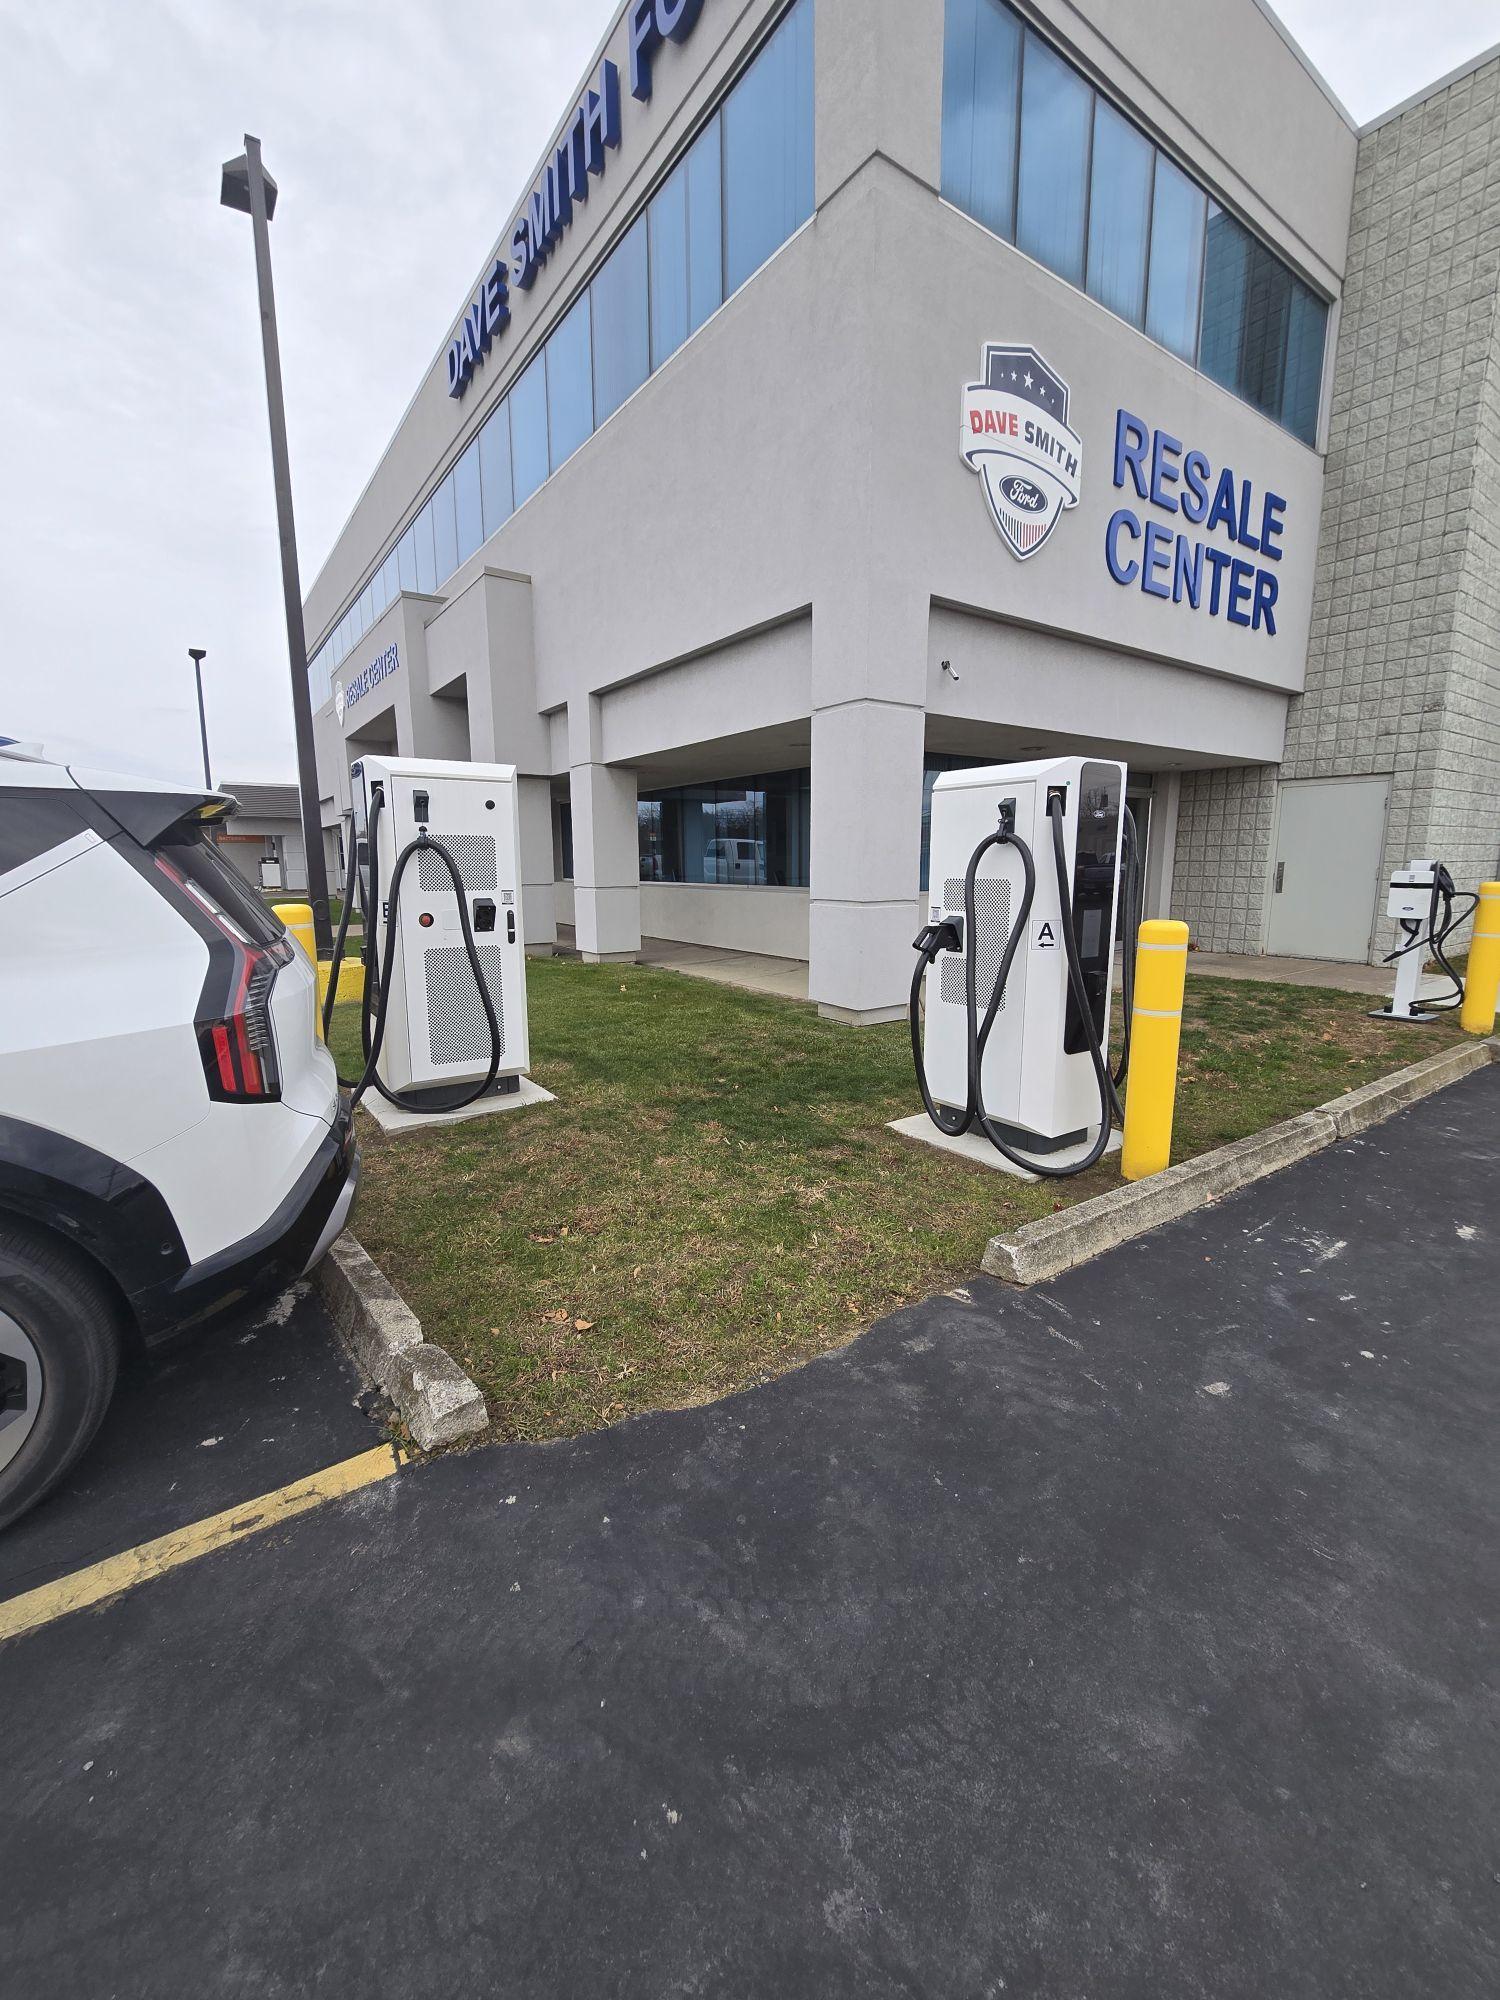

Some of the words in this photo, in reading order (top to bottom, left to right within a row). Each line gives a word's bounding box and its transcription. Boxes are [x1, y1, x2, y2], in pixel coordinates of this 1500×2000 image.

[449, 259, 511, 399] DAVE
[509, 59, 621, 290] SMITH
[969, 409, 1018, 437] DAVE
[1024, 420, 1078, 478] SMITH
[1009, 479, 1039, 509] Ford
[1112, 408, 1287, 562] RESALE
[1105, 508, 1279, 636] CENTER
[368, 642, 400, 688] CENTER
[1037, 922, 1055, 941] A
